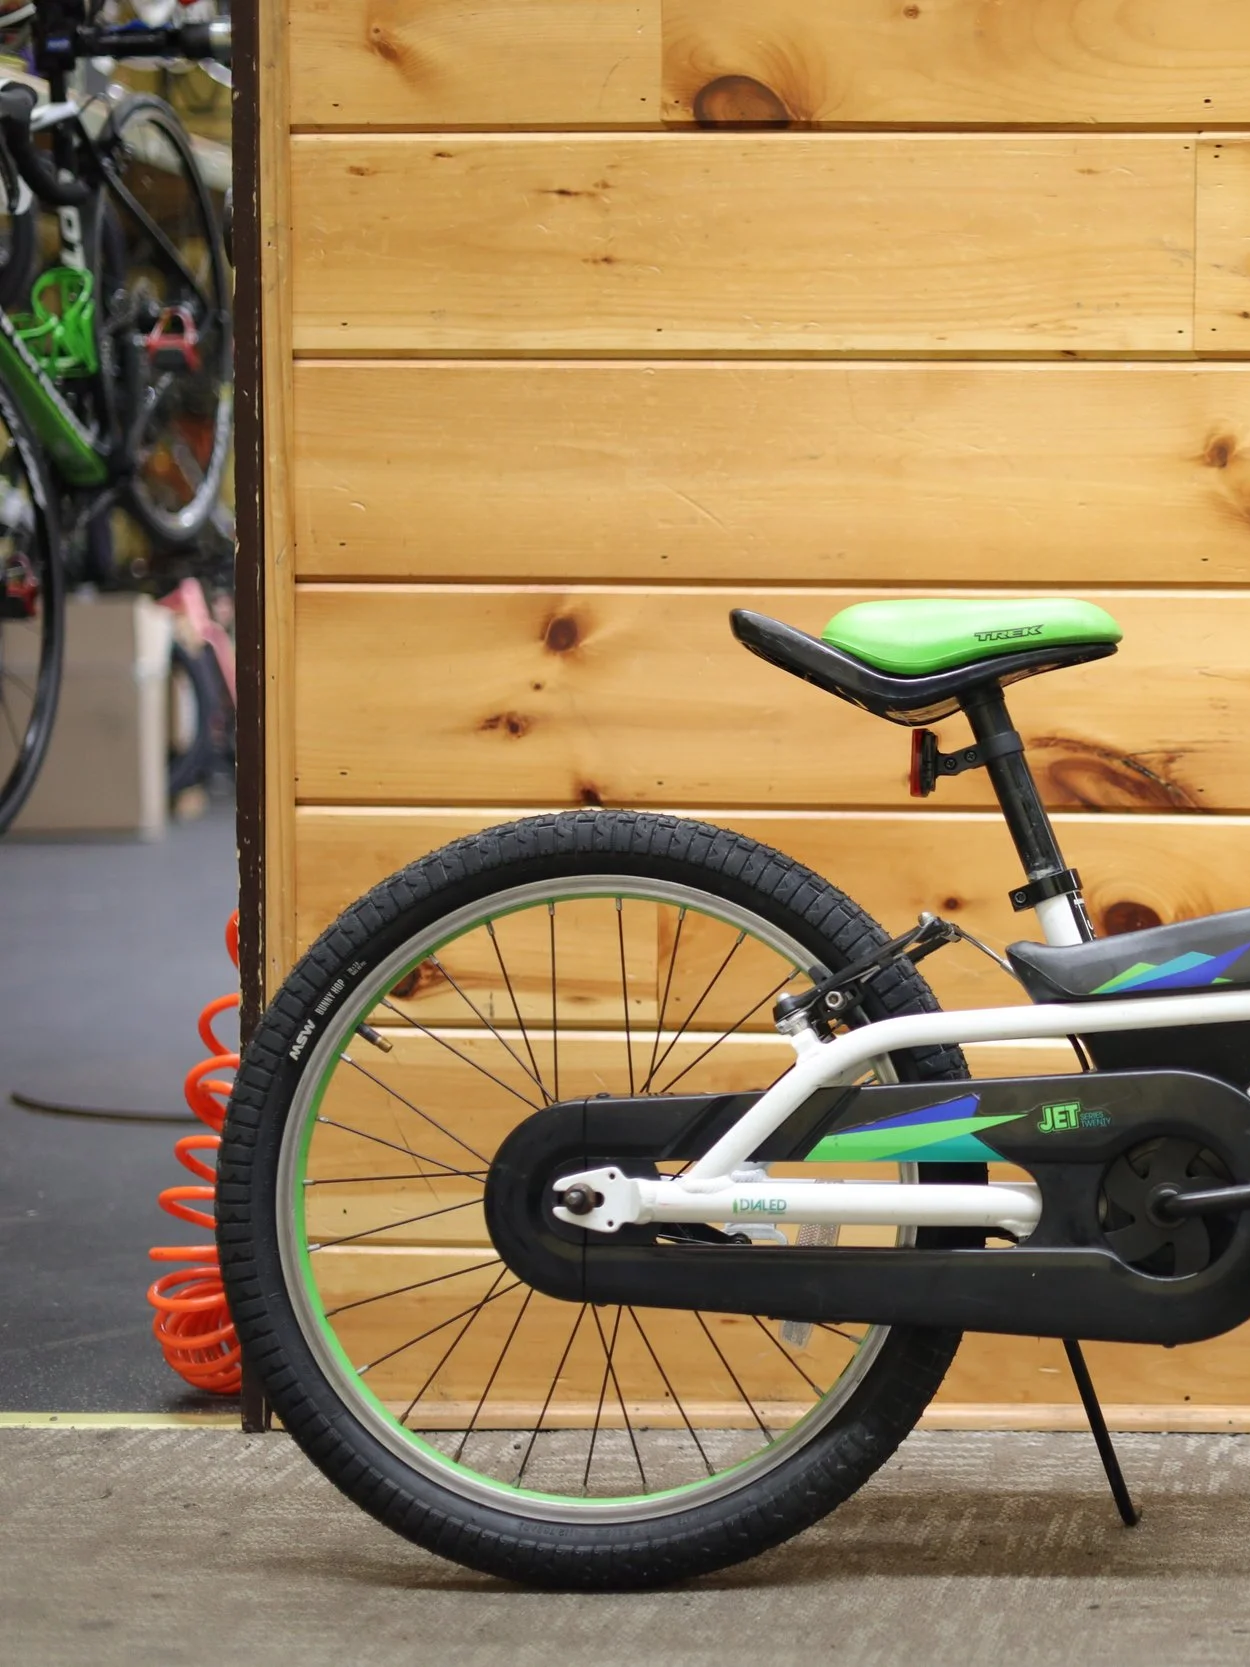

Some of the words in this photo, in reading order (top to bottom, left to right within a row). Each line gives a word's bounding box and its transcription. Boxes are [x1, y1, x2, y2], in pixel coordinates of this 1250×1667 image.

[974, 624, 1044, 642] TREK
[289, 1019, 316, 1061] MSW
[315, 992, 336, 1016] BUNNY
[331, 979, 345, 998] HOP
[1038, 1102, 1080, 1133] JET
[740, 1198, 787, 1211] DIALED
